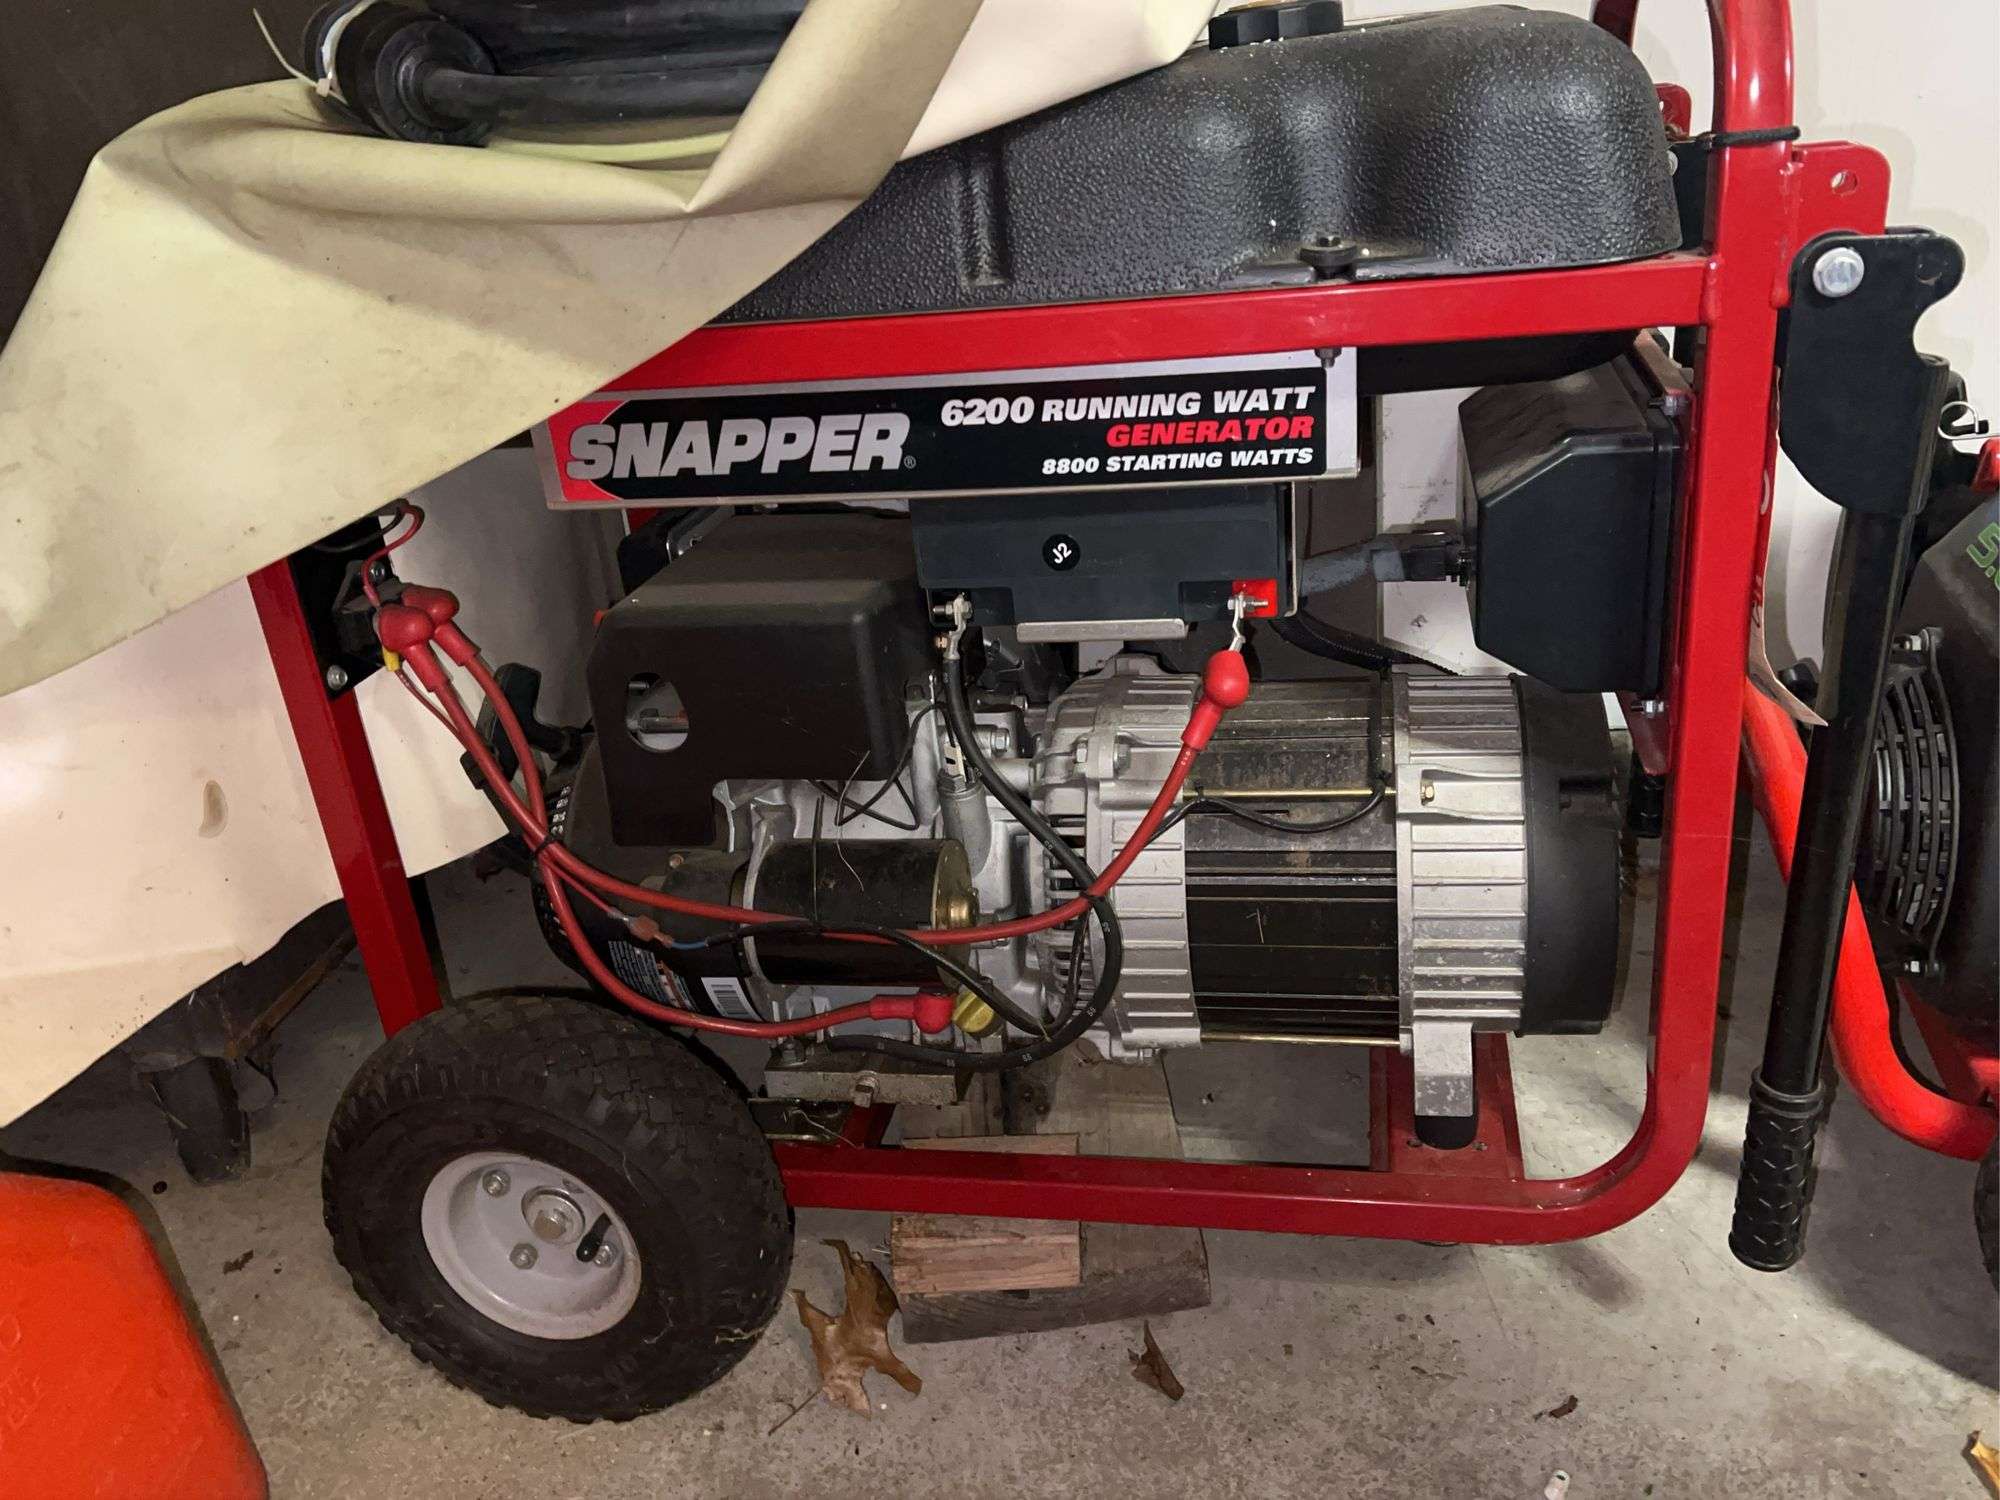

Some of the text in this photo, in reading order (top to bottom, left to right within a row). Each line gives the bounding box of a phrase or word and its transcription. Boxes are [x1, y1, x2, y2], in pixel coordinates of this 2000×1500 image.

[940, 385, 1317, 427] 6200 RUNNING WATT
[1106, 415, 1315, 448] GENERATOR
[1041, 447, 1314, 475] 8800 STARTING WATTS
